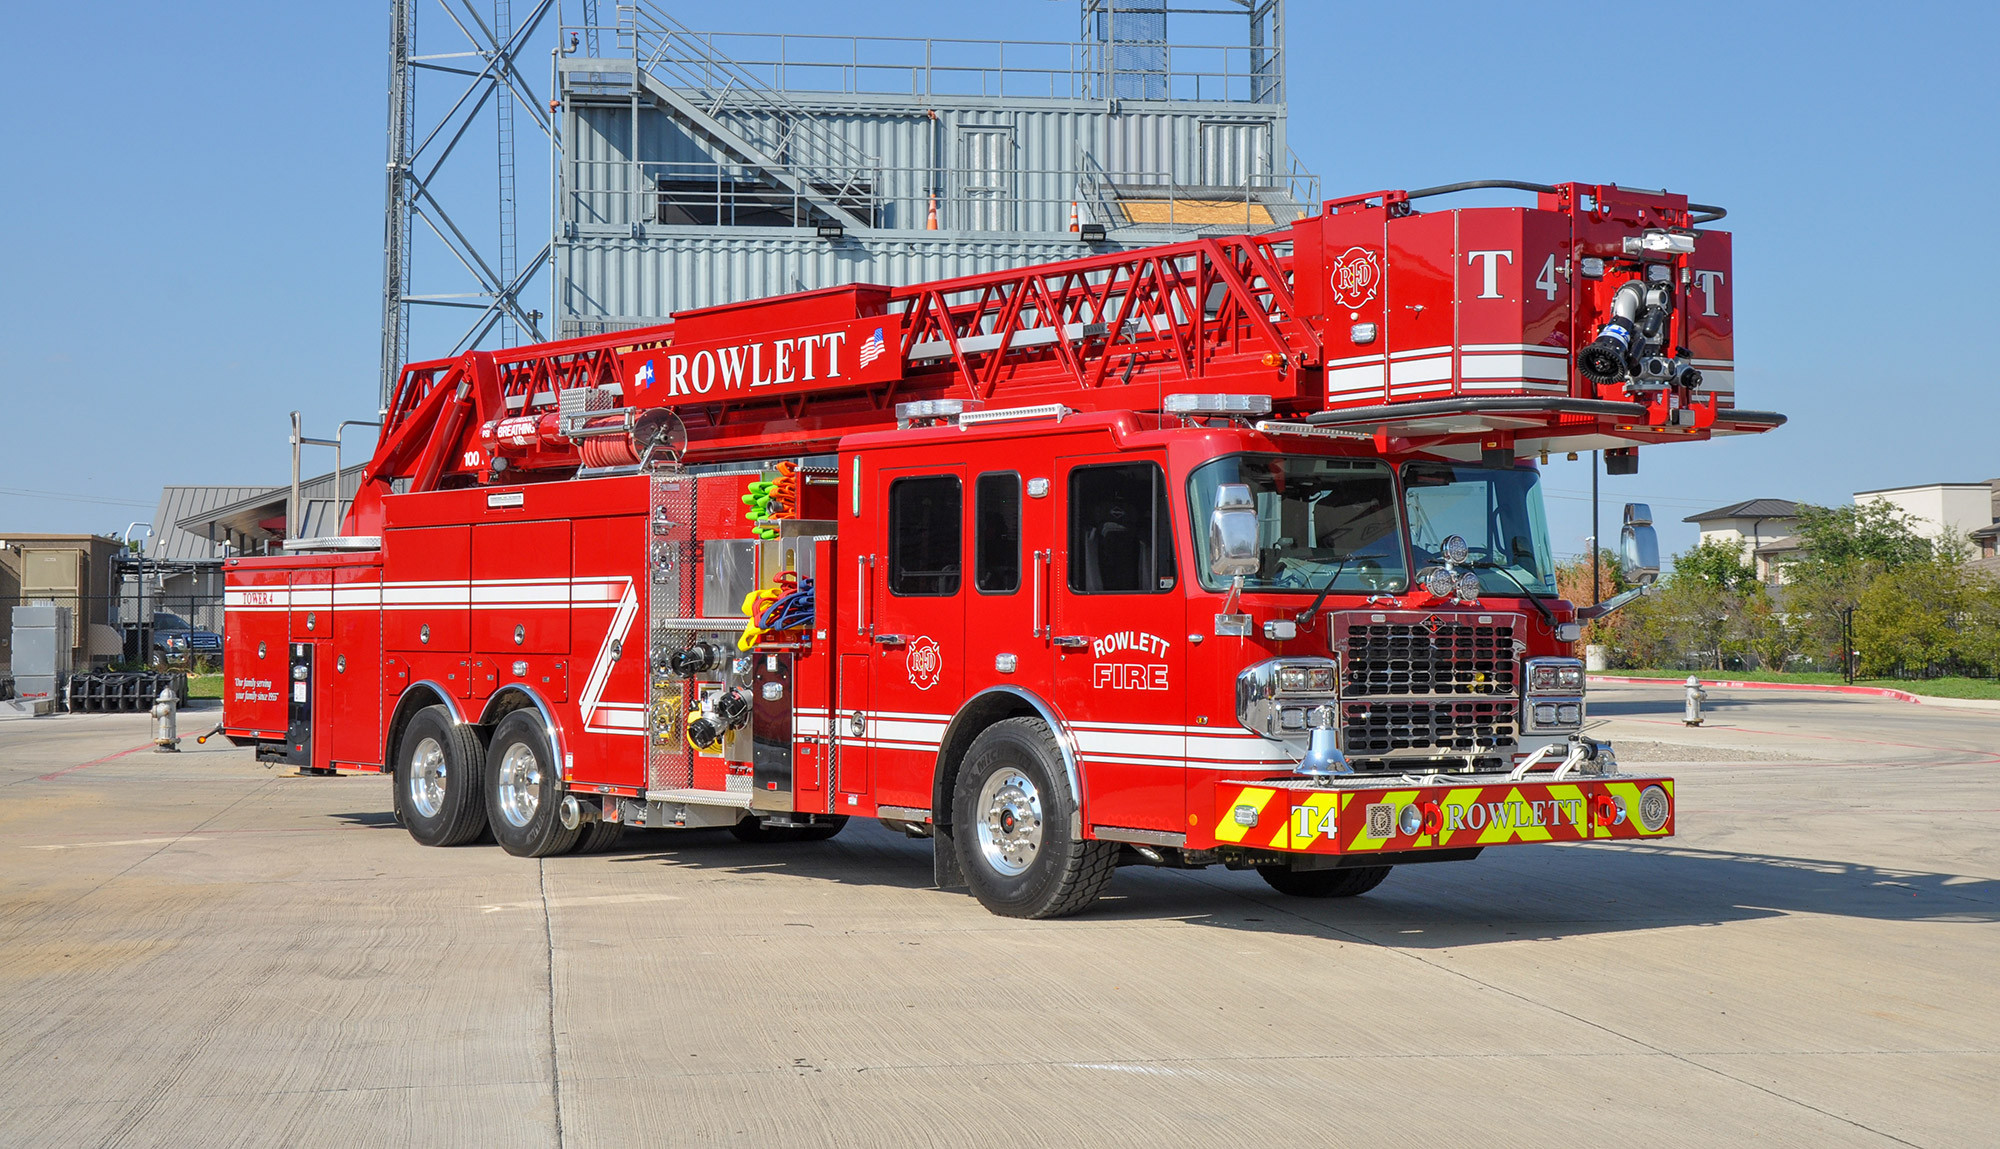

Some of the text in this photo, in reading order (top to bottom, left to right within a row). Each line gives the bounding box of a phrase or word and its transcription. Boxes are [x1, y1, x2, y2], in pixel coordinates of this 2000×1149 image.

[1468, 250, 1558, 301] T 4
[1695, 270, 1725, 317] T
[667, 331, 846, 397] ROWLETT
[497, 422, 536, 438] BREATHING
[463, 451, 480, 467] 100
[243, 592, 273, 605] TOWER 4
[1093, 631, 1170, 659] ROWLETT
[1093, 663, 1169, 690] FIRE
[1291, 804, 1339, 839] T4
[1447, 799, 1581, 831] ROWLETT
